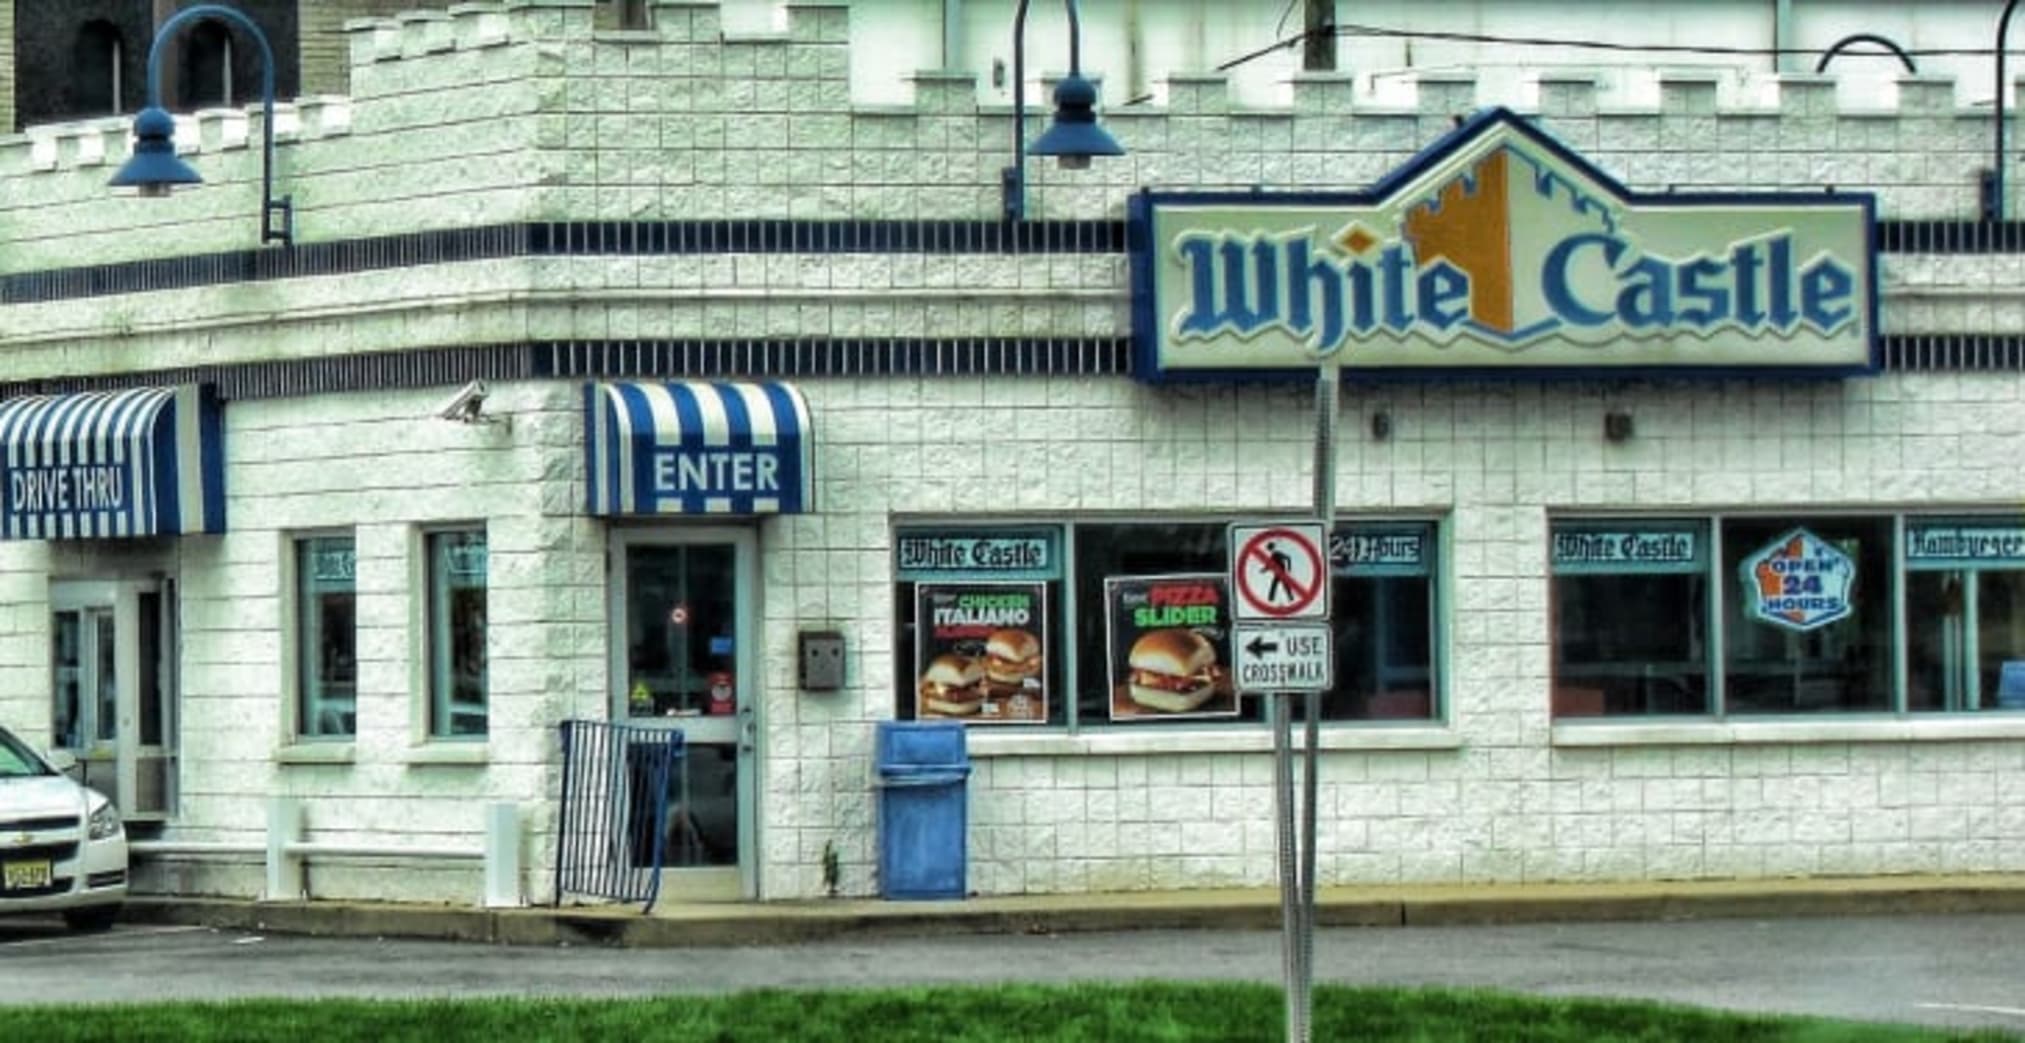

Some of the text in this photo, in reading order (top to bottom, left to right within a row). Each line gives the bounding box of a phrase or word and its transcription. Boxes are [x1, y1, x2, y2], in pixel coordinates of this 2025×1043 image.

[1180, 229, 1853, 347] White Castle
[653, 452, 780, 491] ENTER
[11, 466, 124, 512] DRIVE THRU
[902, 537, 1042, 568] White Castle
[1556, 532, 1689, 562] White Castle
[1771, 559, 1834, 573] OPEN
[1150, 585, 1220, 605] PIZZA
[1783, 575, 1823, 595] 24
[959, 594, 1031, 608] CHICKEN
[1766, 597, 1840, 611] HOURS
[933, 607, 1031, 626] ITALIANO
[1133, 605, 1218, 627] SLIDER
[1285, 635, 1324, 657] USE
[1242, 661, 1325, 683] CROSSWALK
